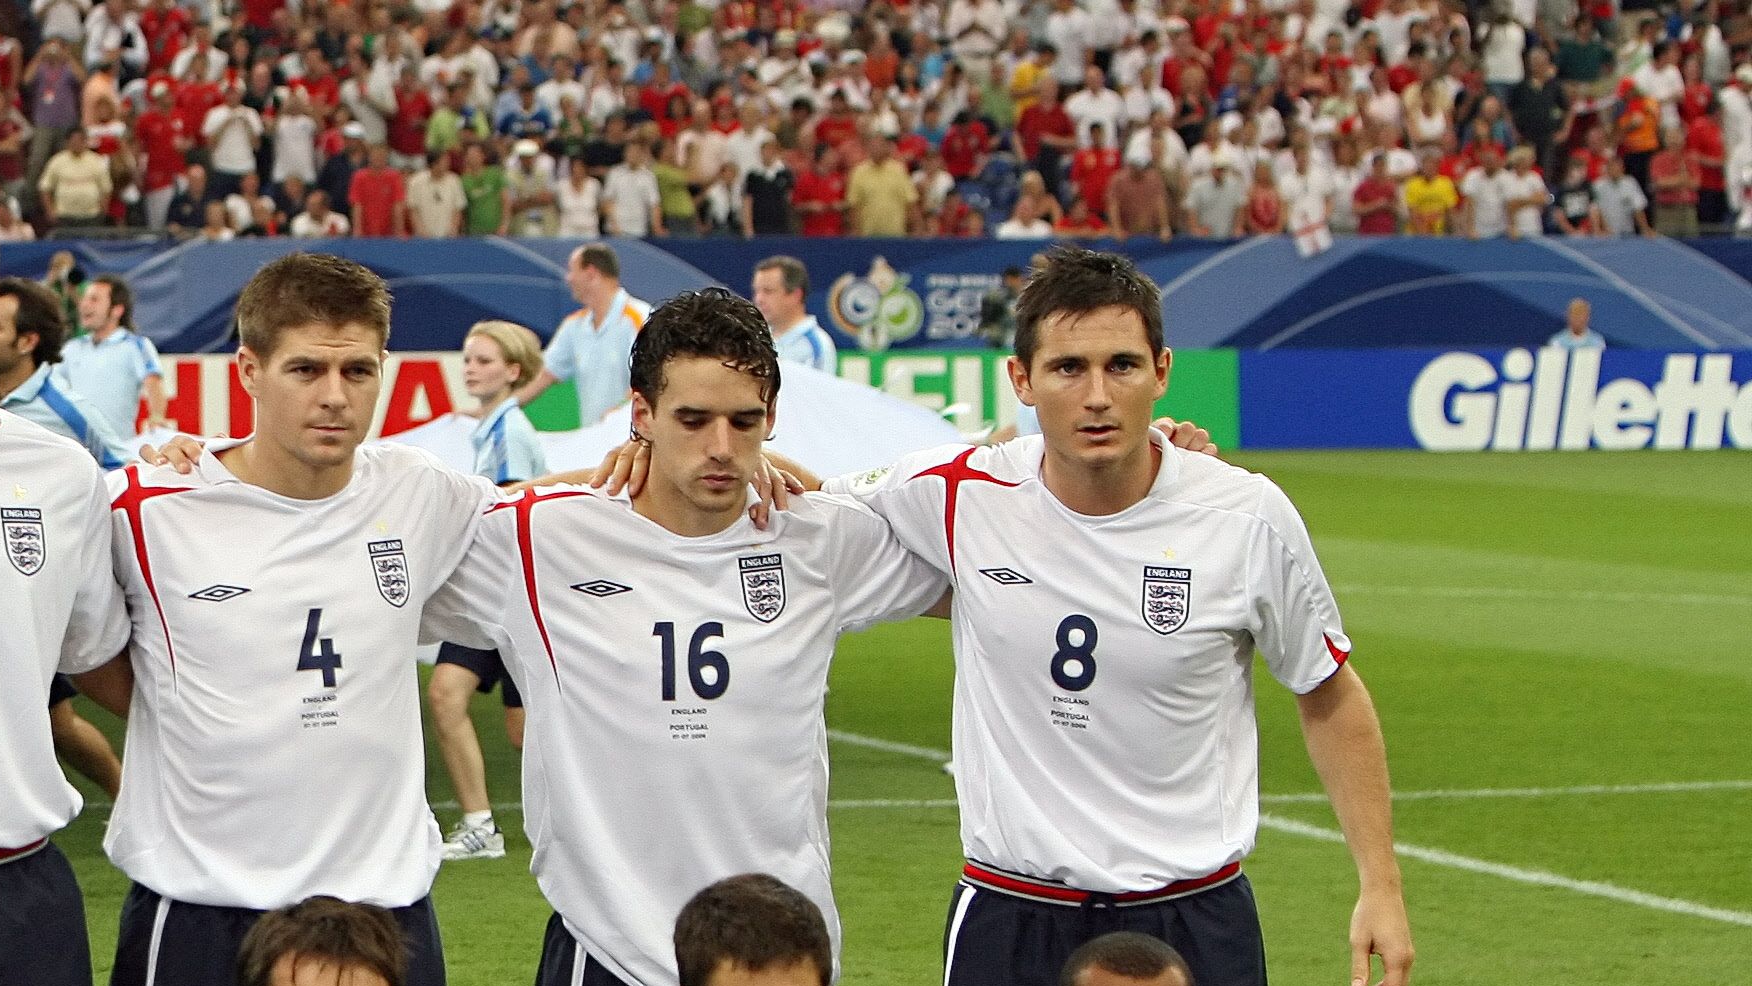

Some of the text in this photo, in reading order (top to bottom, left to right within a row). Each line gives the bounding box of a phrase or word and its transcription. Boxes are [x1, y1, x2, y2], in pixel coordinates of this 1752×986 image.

[1146, 568, 1189, 579] ENGLAND
[296, 608, 342, 688] 4
[1050, 614, 1098, 691] 8
[652, 621, 730, 701] 16
[1052, 696, 1090, 706] ENGLAND
[1050, 709, 1091, 722] PORTUGAL
[669, 723, 710, 731] PORTUGAL
